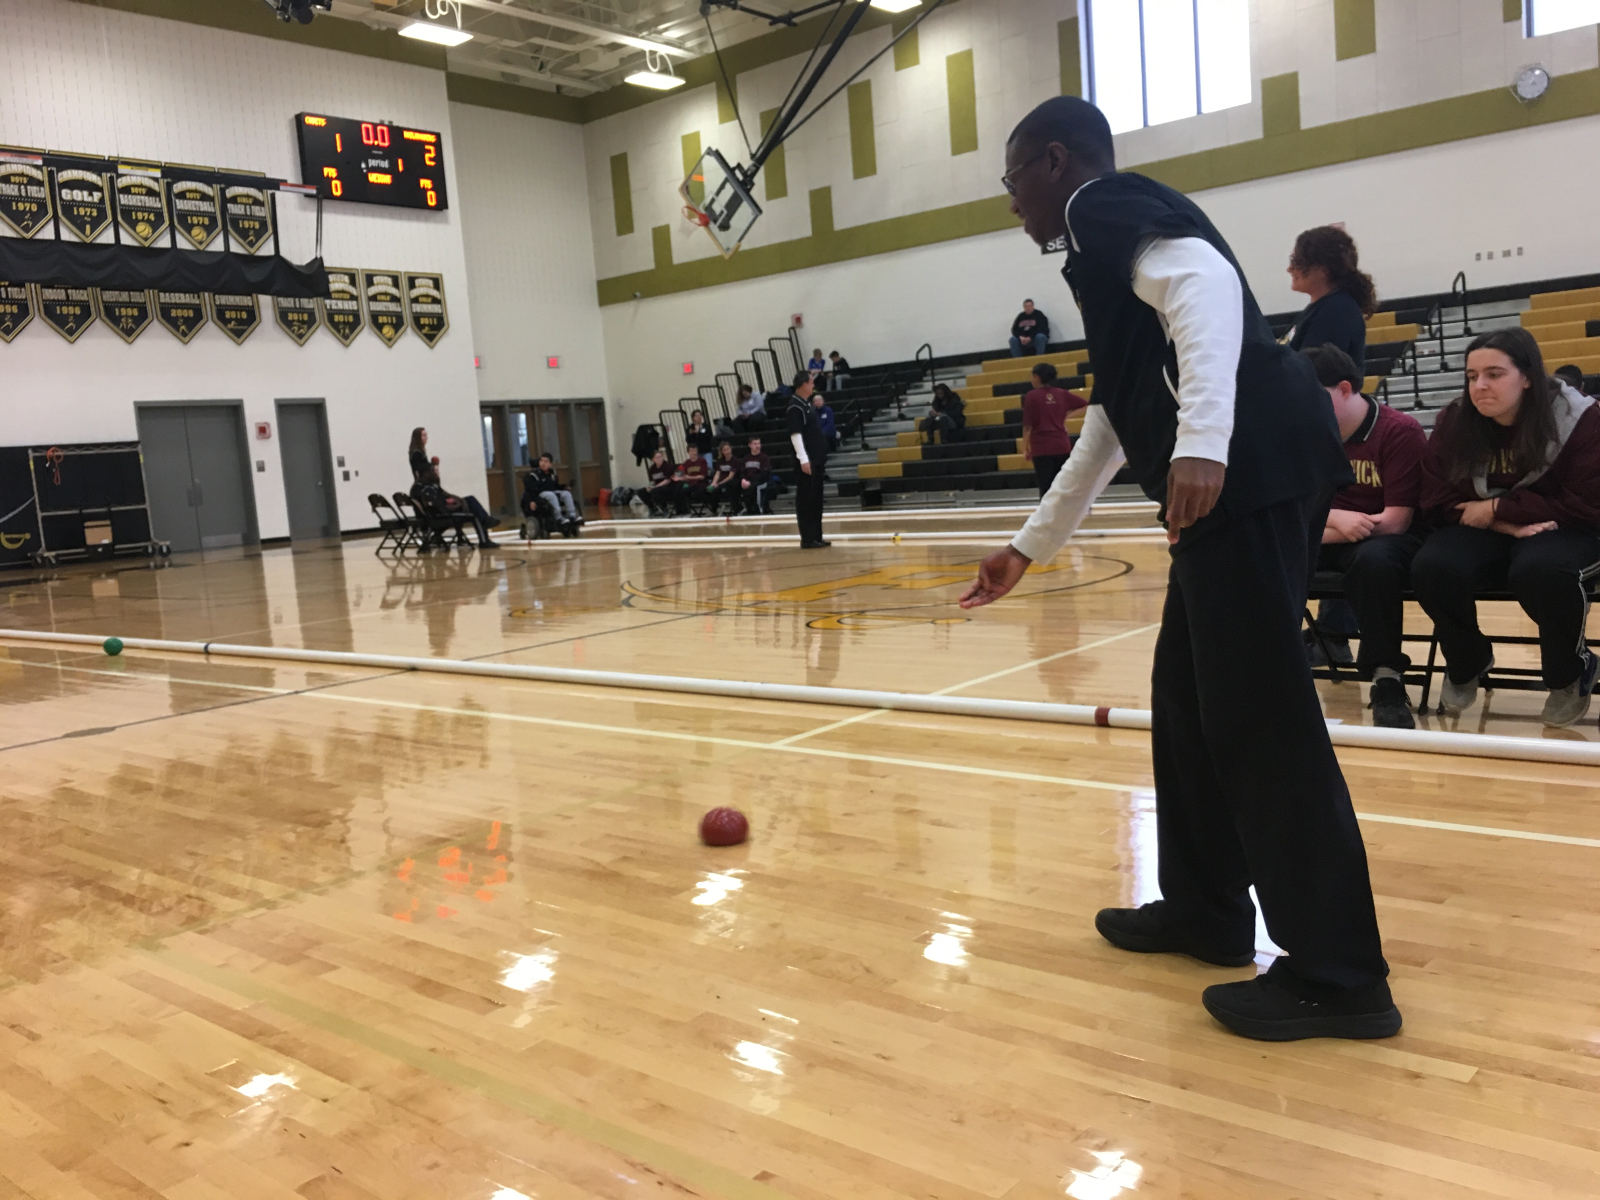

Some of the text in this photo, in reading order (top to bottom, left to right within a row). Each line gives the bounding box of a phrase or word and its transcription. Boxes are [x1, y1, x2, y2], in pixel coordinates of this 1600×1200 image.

[336, 134, 342, 153] 1
[362, 123, 391, 148] 0.0
[368, 159, 389, 168] period
[425, 145, 436, 166] 2
[0, 164, 43, 181] HAMPIONS
[399, 159, 404, 173] 1
[58, 170, 103, 187] CHAMPIONS
[118, 175, 160, 193] CHAMPIONS
[62, 189, 102, 203] GOLF
[173, 181, 214, 198] CHAMPIONS
[226, 186, 264, 203] CHAMPIONS
[332, 180, 343, 197] 0
[120, 194, 161, 209] BASKETBALL
[176, 200, 215, 213] BASKETBALL
[427, 191, 437, 207] 0
[132, 212, 155, 222] 1974
[1046, 234, 1068, 251] SE
[330, 283, 358, 297] HAMPIONS
[160, 293, 200, 304] BASEBALL
[216, 295, 253, 306] SWIMMING
[326, 301, 358, 310] TENNIS
